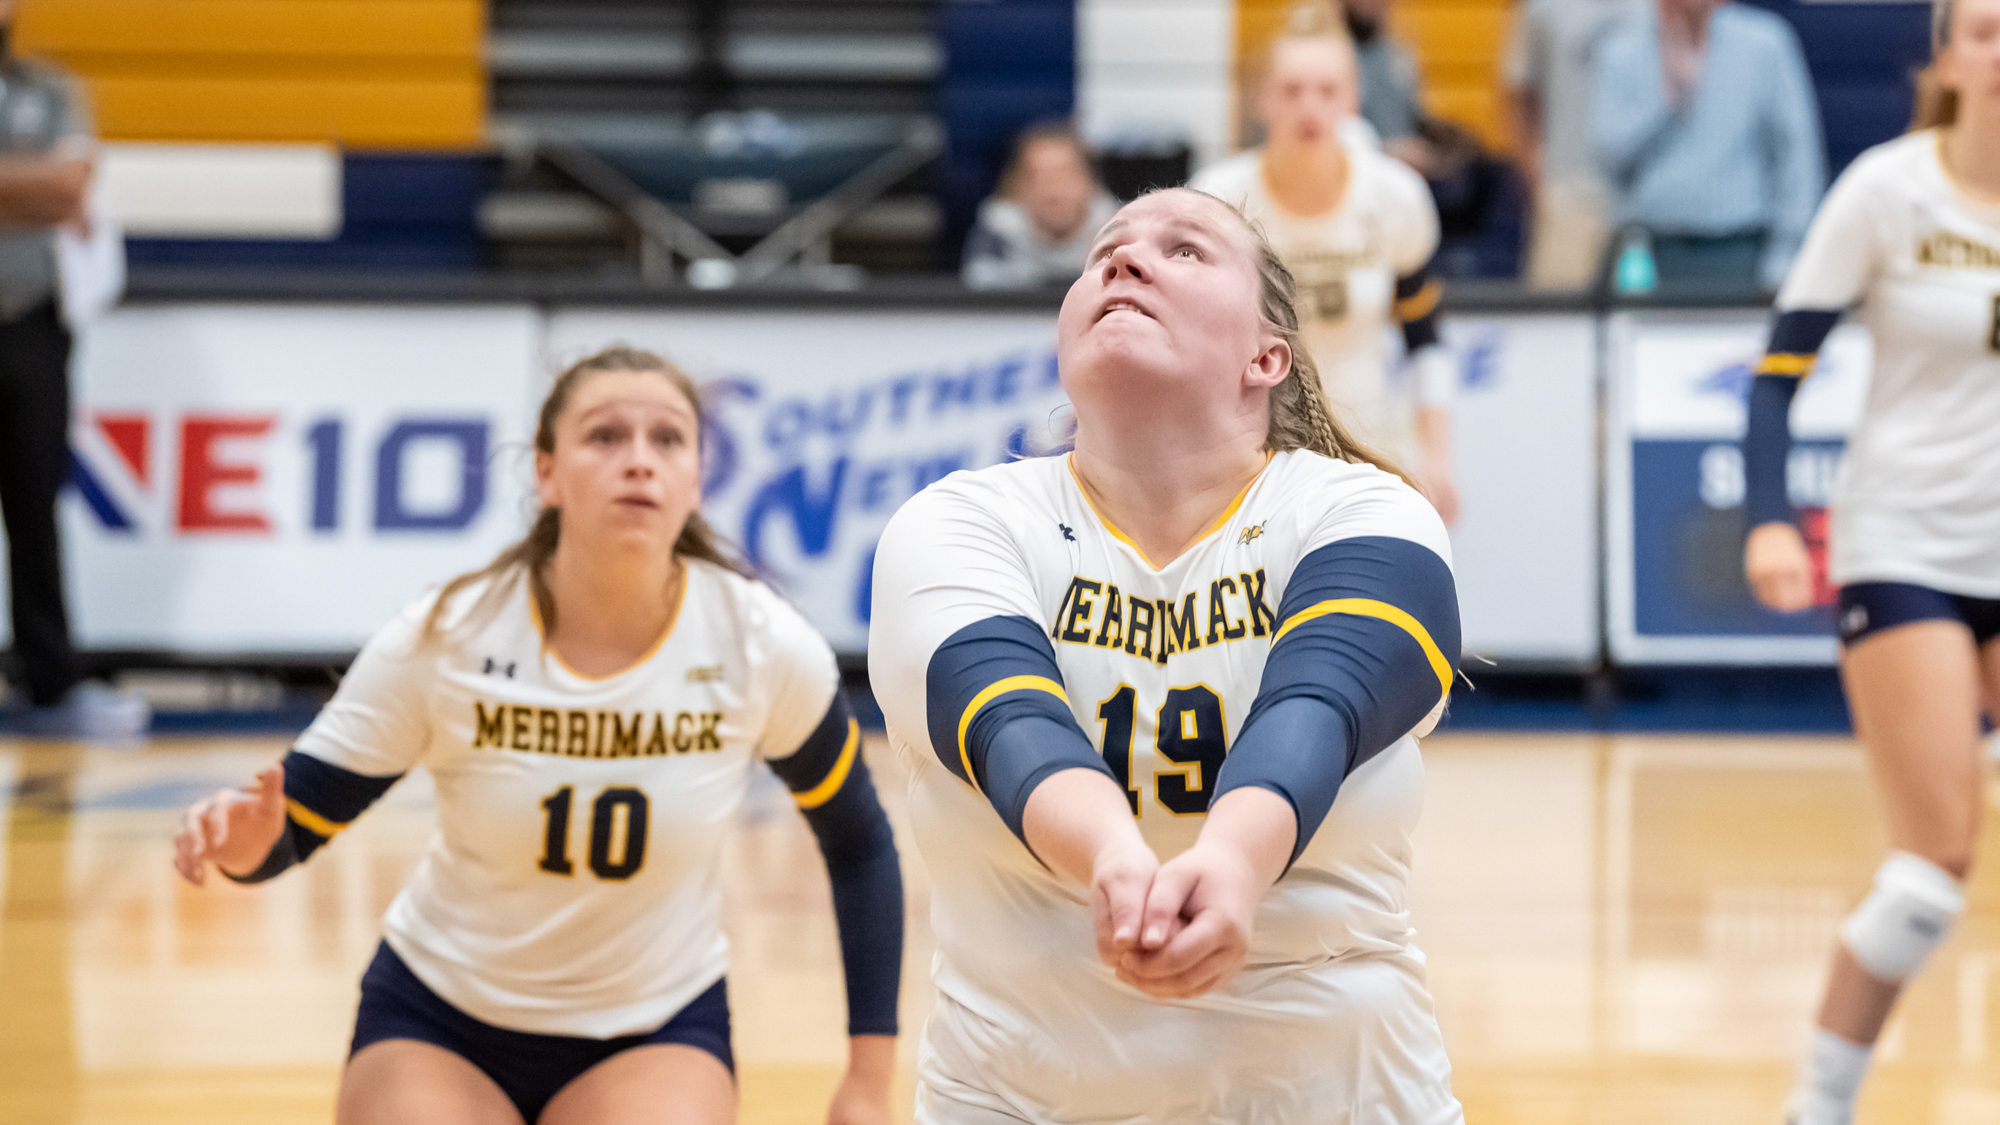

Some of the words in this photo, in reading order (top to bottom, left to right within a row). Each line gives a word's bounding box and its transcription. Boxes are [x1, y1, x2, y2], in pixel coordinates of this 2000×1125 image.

[700, 350, 1061, 498] SOUTHE
[473, 700, 724, 759] MERRIMACK
[1095, 681, 1229, 819] 19
[537, 783, 651, 882] 10
